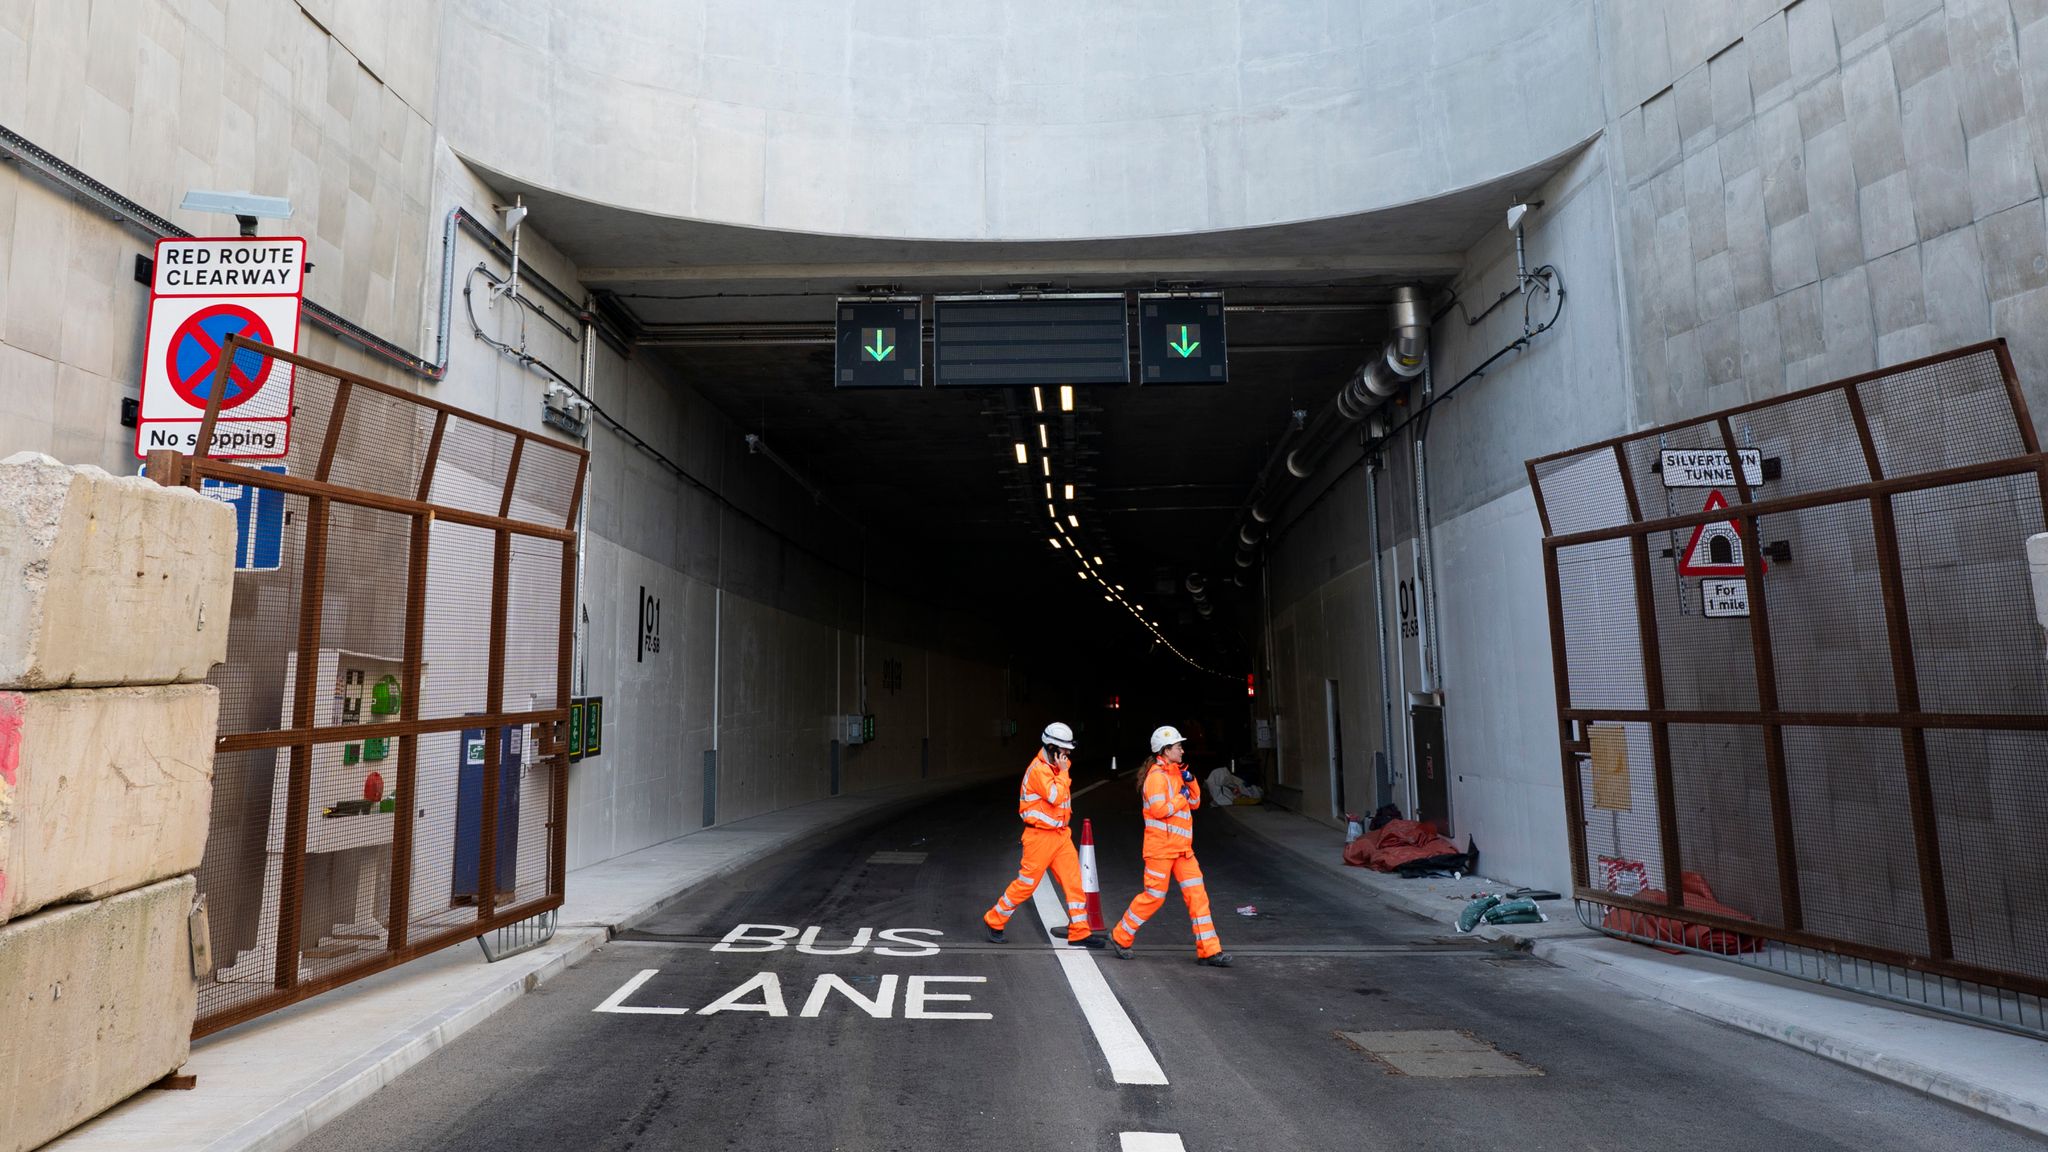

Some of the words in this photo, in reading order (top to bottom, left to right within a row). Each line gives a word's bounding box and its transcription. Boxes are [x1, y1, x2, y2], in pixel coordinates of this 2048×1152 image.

[166, 249, 211, 265] RED
[219, 248, 294, 264] ROUTE
[166, 269, 291, 286] CLEARWAY
[150, 430, 179, 447] No
[186, 429, 276, 448] sopping
[1684, 469, 1734, 480] TUNNE
[1399, 576, 1417, 620] 01
[1715, 584, 1736, 596] For
[1708, 599, 1714, 610] 1
[1719, 598, 1745, 610] mile
[645, 594, 661, 636] 01
[709, 922, 944, 957] BUS
[591, 968, 993, 1020] LANE
